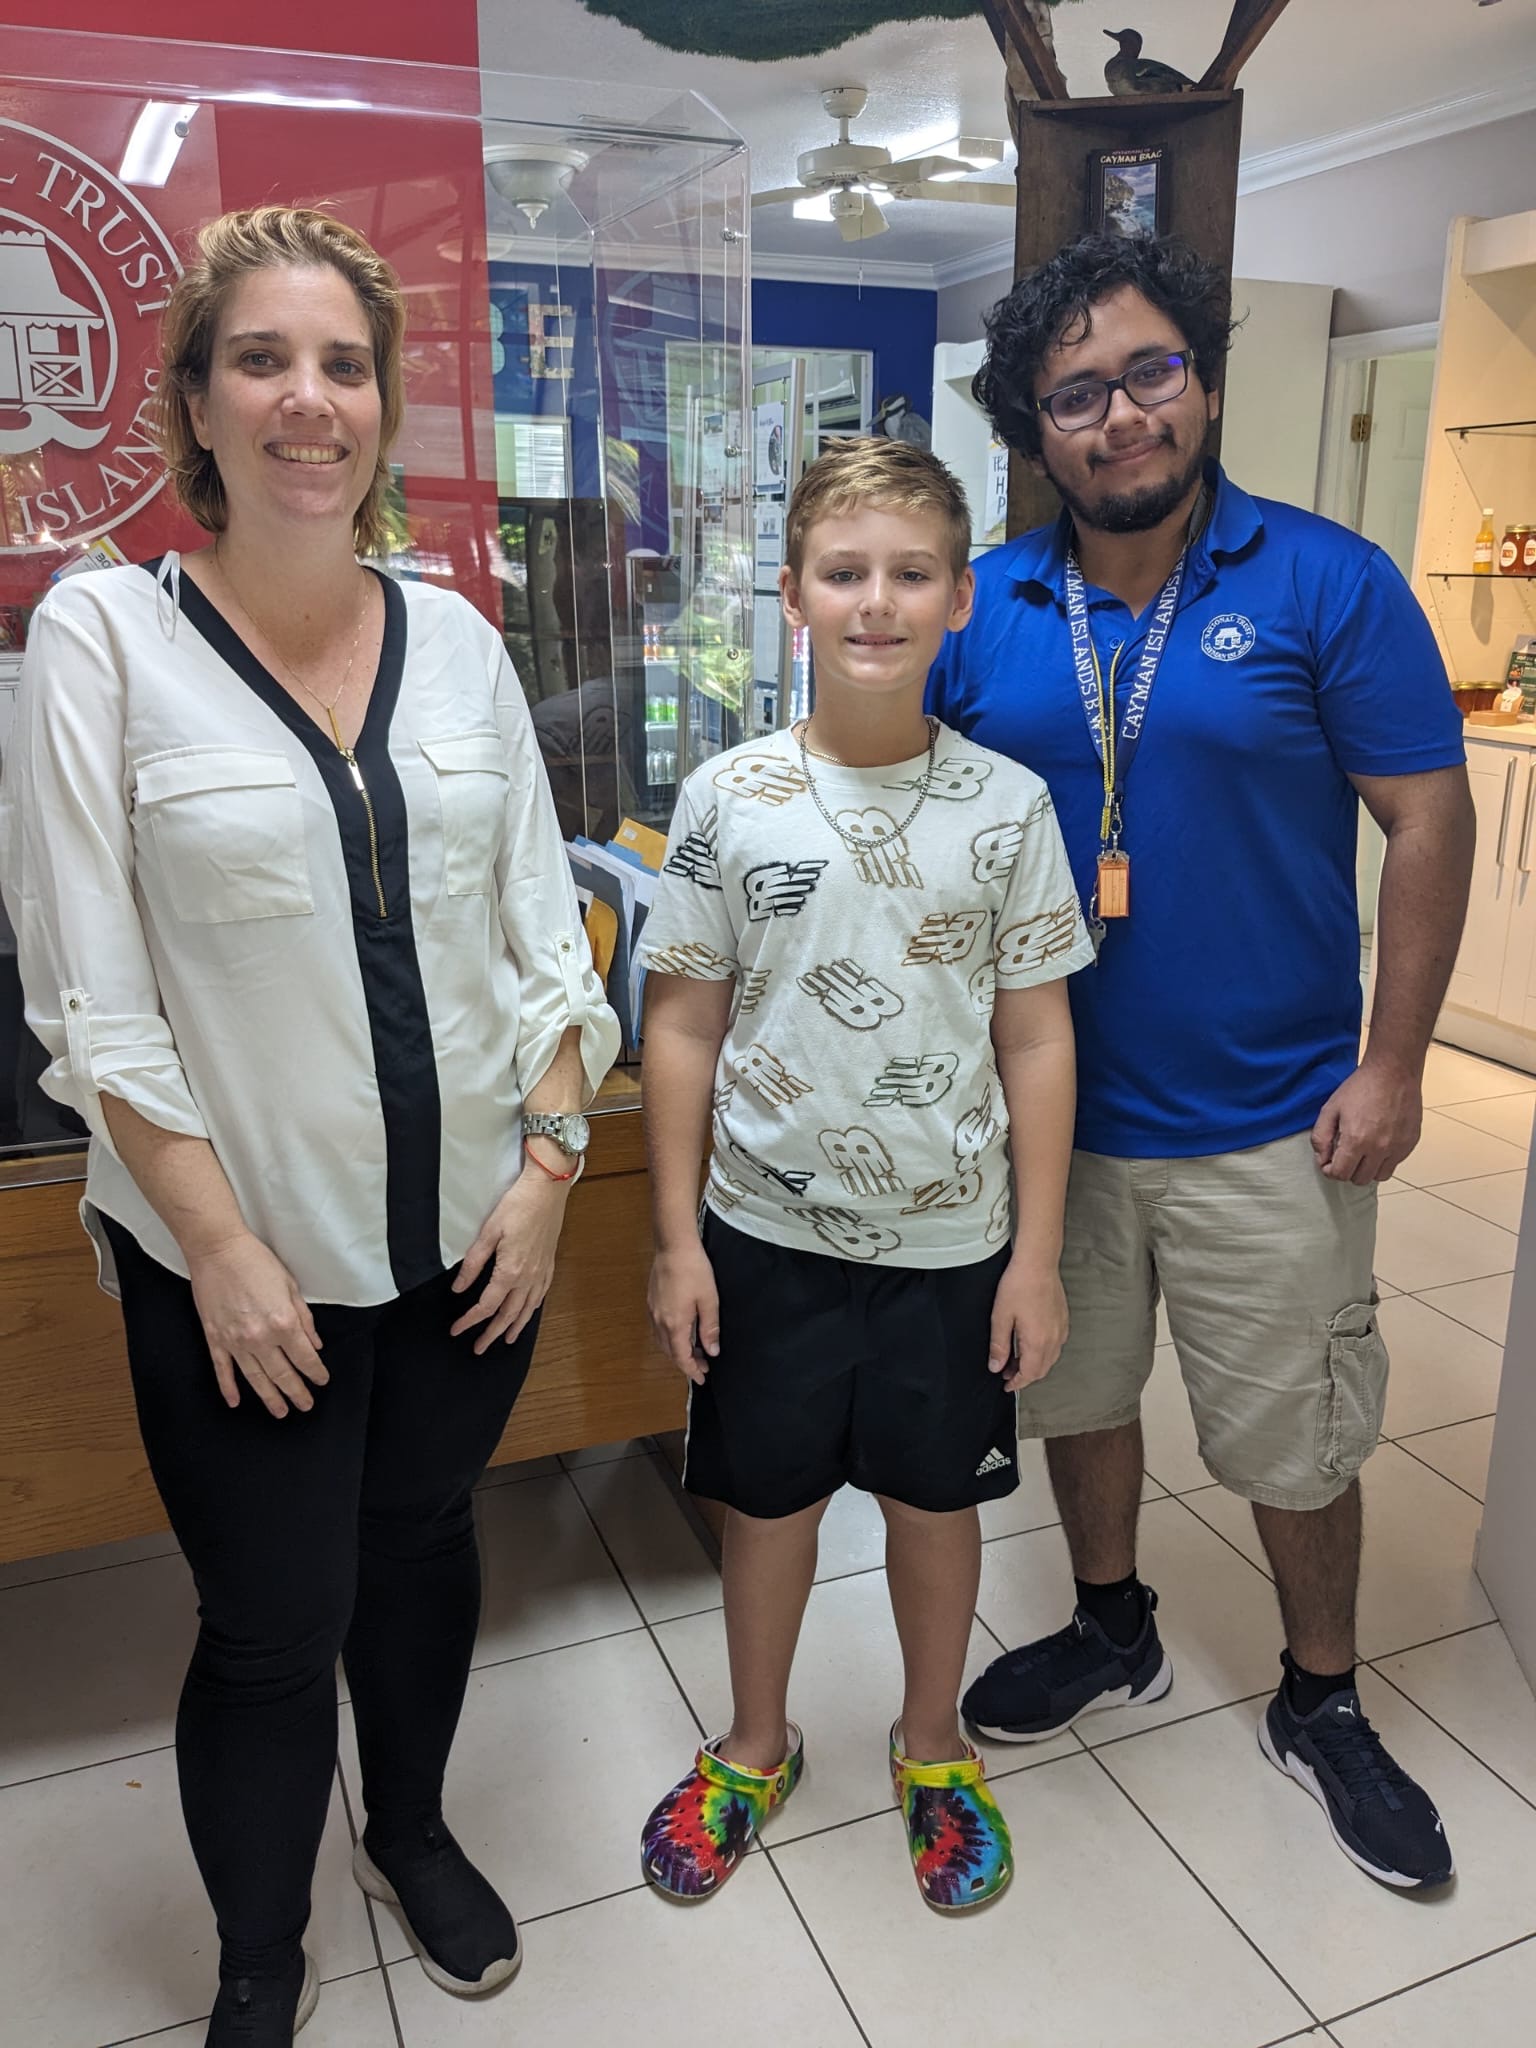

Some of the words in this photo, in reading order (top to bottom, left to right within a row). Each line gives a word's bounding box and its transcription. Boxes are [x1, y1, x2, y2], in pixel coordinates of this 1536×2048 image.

[1100, 154, 1137, 165] CAYMAN
[37, 152, 173, 317] TRUST
[1070, 618, 1098, 696] ISLANDS
[1122, 656, 1155, 740] CAYMAN
[1144, 575, 1181, 653] ISLANDS
[975, 1456, 1012, 1476] adidas
